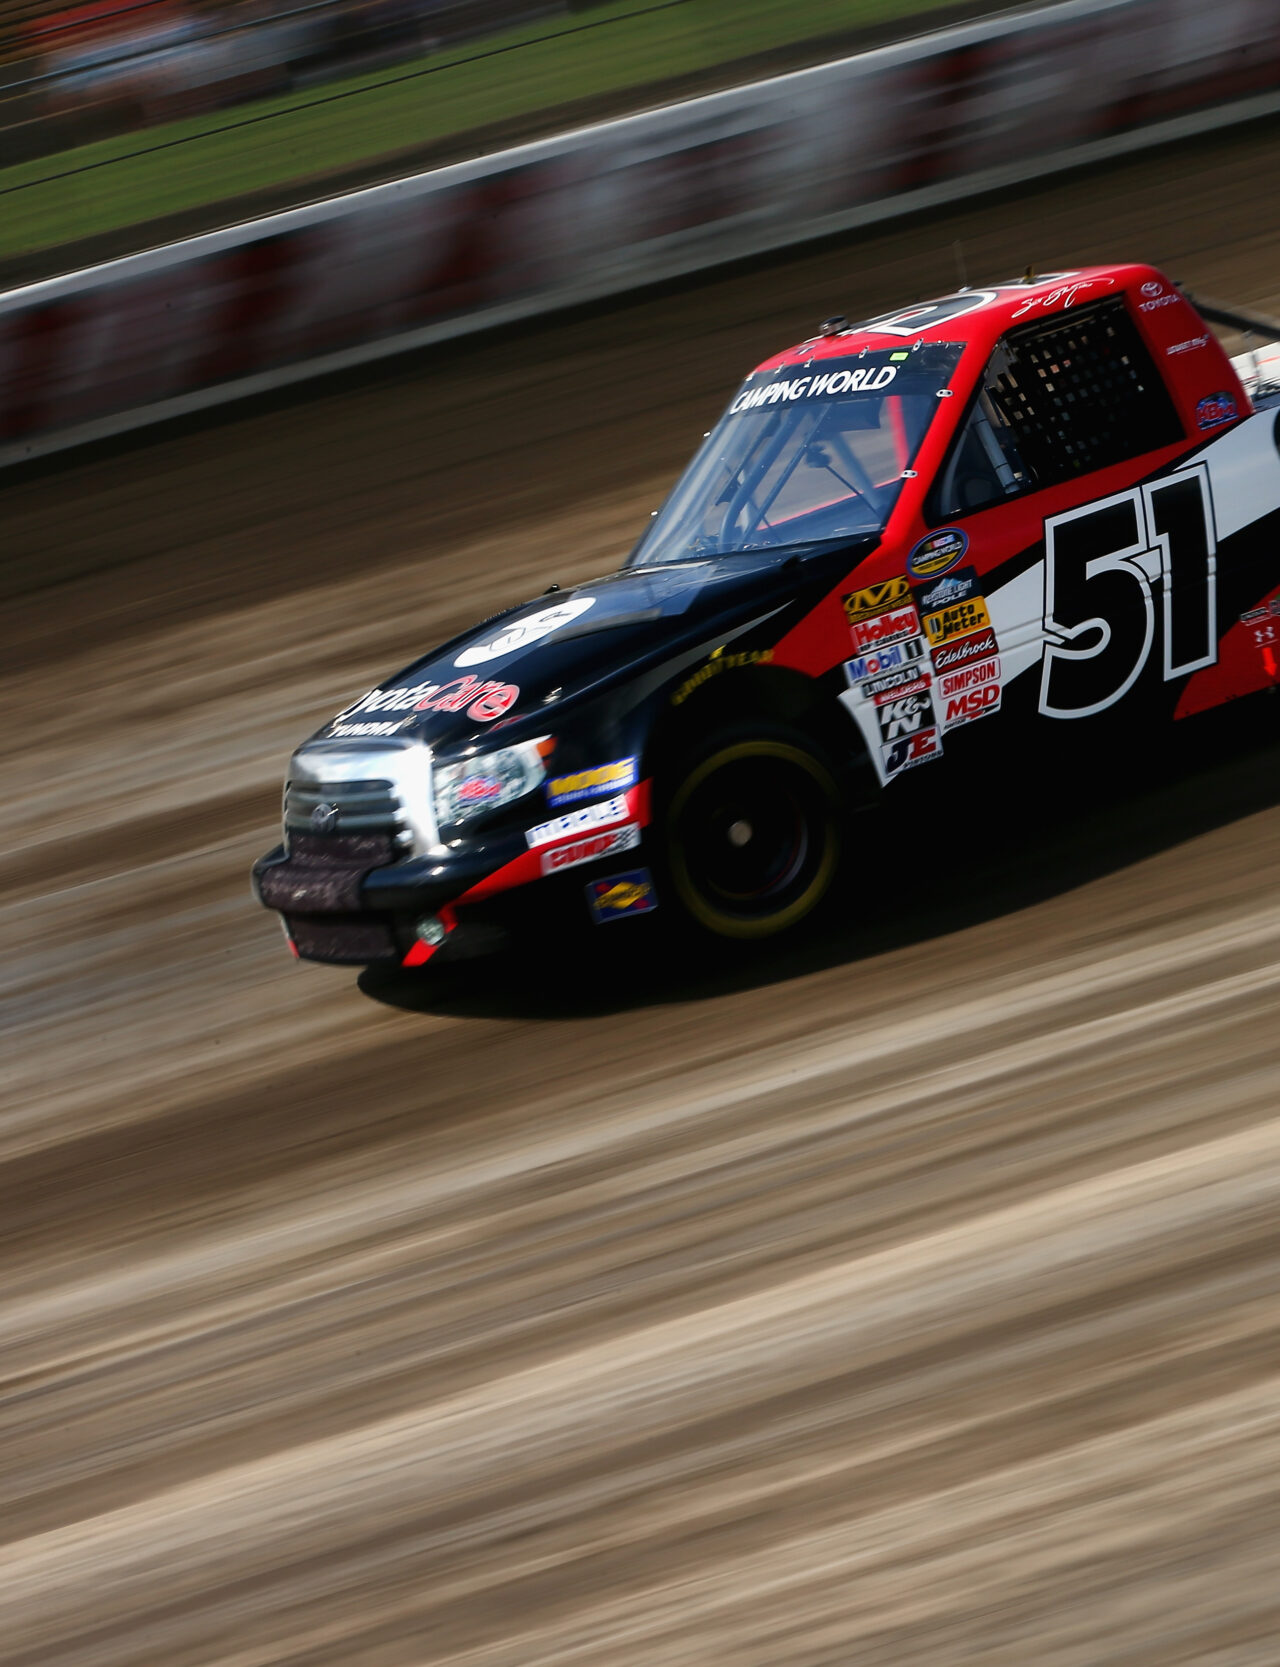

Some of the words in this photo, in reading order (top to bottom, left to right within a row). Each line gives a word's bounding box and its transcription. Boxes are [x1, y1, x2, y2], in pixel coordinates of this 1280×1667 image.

[1138, 294, 1180, 313] TOYOTA
[729, 376, 812, 415] CAMPING
[806, 365, 897, 398] WORLD
[1038, 460, 1217, 719] 51
[854, 611, 918, 646] Holley
[943, 604, 975, 621] Auto
[943, 612, 985, 638] Meter
[848, 645, 903, 681] Mobil
[935, 634, 995, 668] Edelbrock
[863, 668, 920, 698] LINCOLN
[943, 661, 996, 695] SIMPSON
[946, 685, 1000, 721] MSD
[327, 721, 404, 739] TUNDRA
[886, 729, 936, 774] JE
